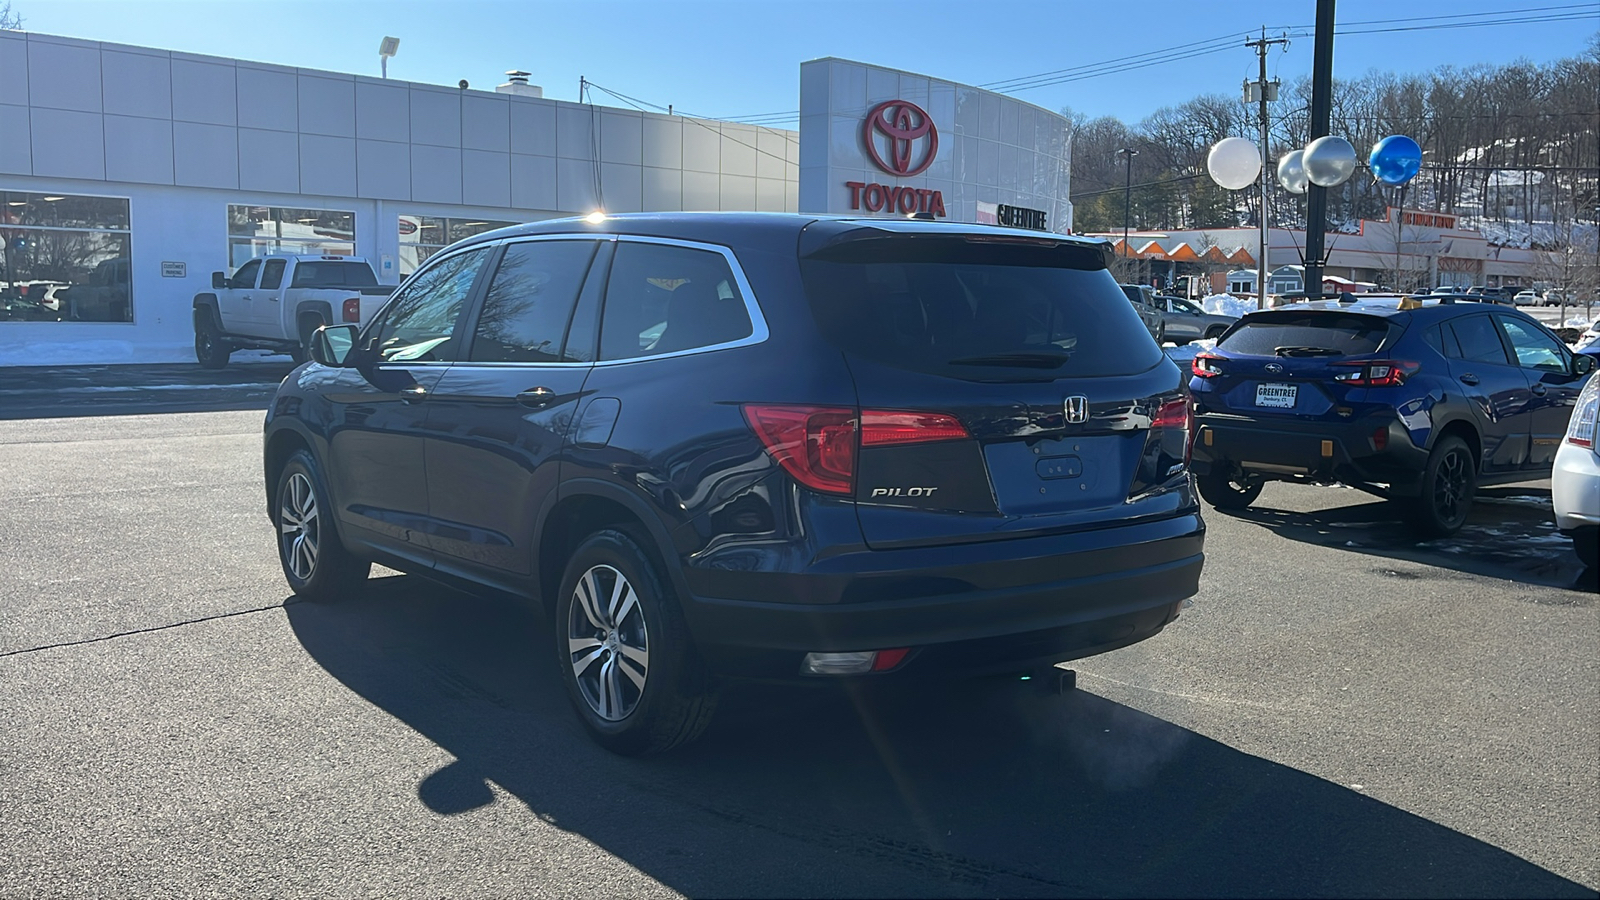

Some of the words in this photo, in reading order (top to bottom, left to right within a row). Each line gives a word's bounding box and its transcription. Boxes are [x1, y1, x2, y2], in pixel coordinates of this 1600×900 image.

[846, 181, 946, 217] TOYOTA
[997, 203, 1047, 231] GREENTREE
[1412, 212, 1433, 227] HOME
[1434, 215, 1455, 229] DEPOT
[1258, 387, 1295, 398] GREENTREE
[870, 487, 938, 498] PILOT
